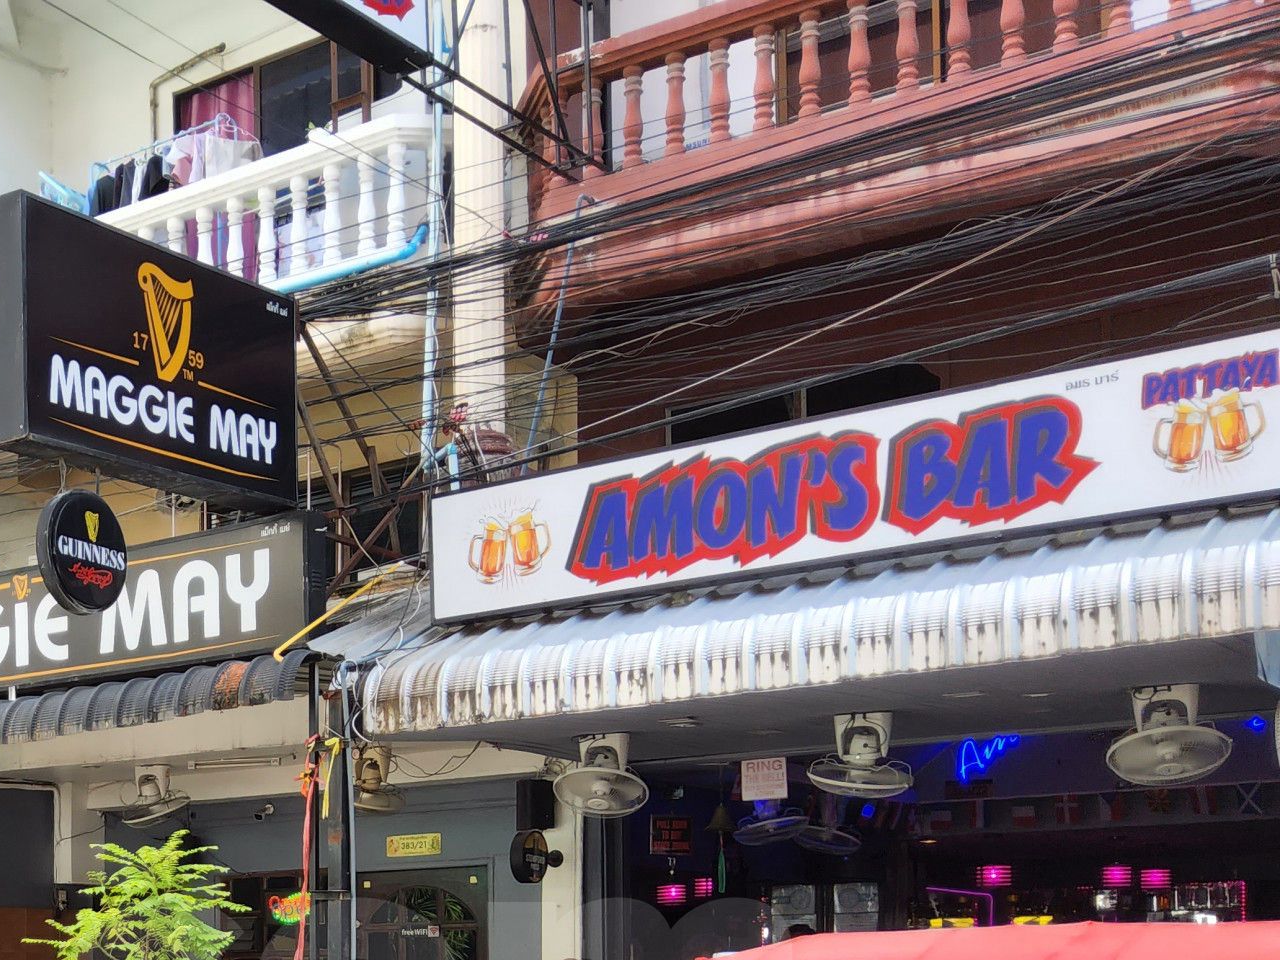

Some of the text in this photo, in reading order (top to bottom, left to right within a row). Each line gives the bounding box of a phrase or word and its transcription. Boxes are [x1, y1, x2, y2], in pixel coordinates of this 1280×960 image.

[133, 331, 149, 351] 17
[187, 350, 205, 370] 59
[1141, 348, 1280, 410] PATTAYA
[49, 353, 277, 465] MAGGIE MAY
[578, 406, 1080, 572] AMON'S BAR
[57, 534, 126, 571] GUINNESS
[98, 547, 271, 655] MAY
[746, 759, 783, 773] RING
[401, 840, 427, 851] 383/21
